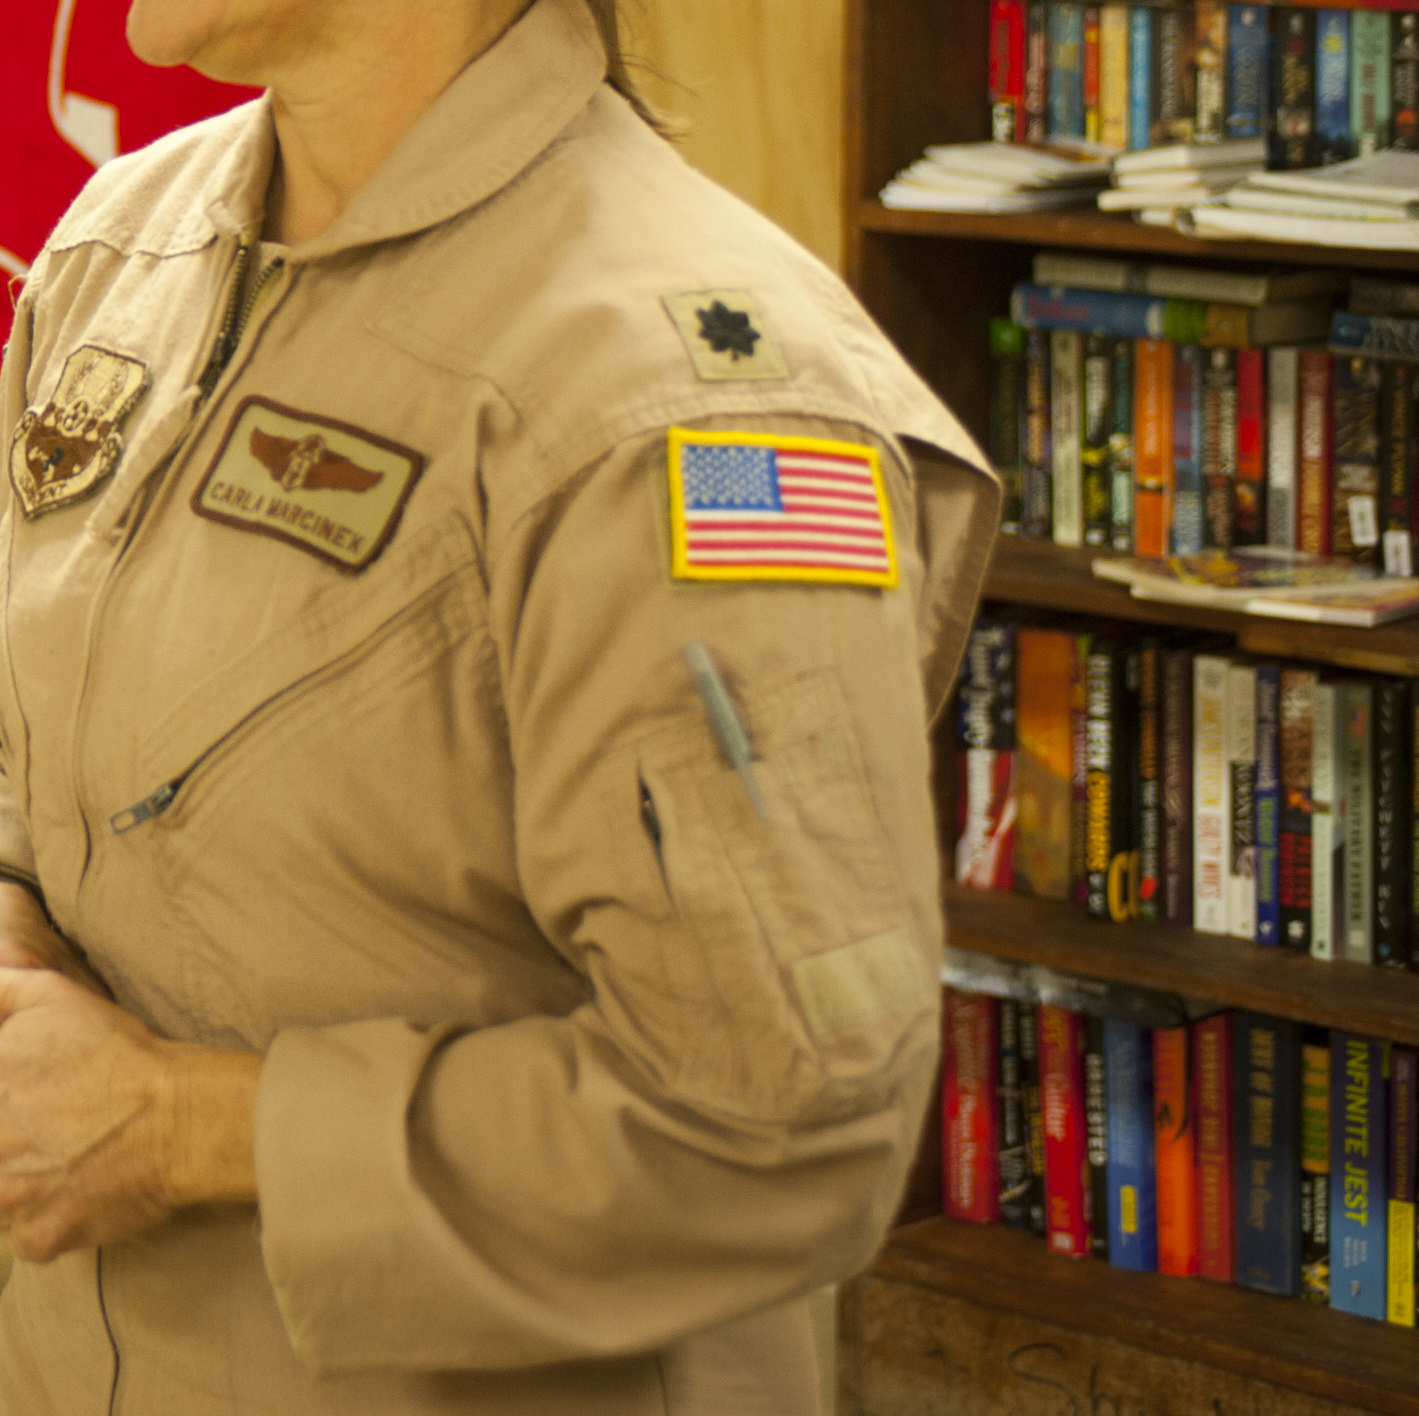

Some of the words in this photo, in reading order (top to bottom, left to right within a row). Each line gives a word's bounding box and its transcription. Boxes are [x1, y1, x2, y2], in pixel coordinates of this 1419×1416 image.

[210, 482, 265, 513] CARLA
[1344, 1039, 1370, 1159] INFINITE
[1344, 1160, 1369, 1228] JEST
